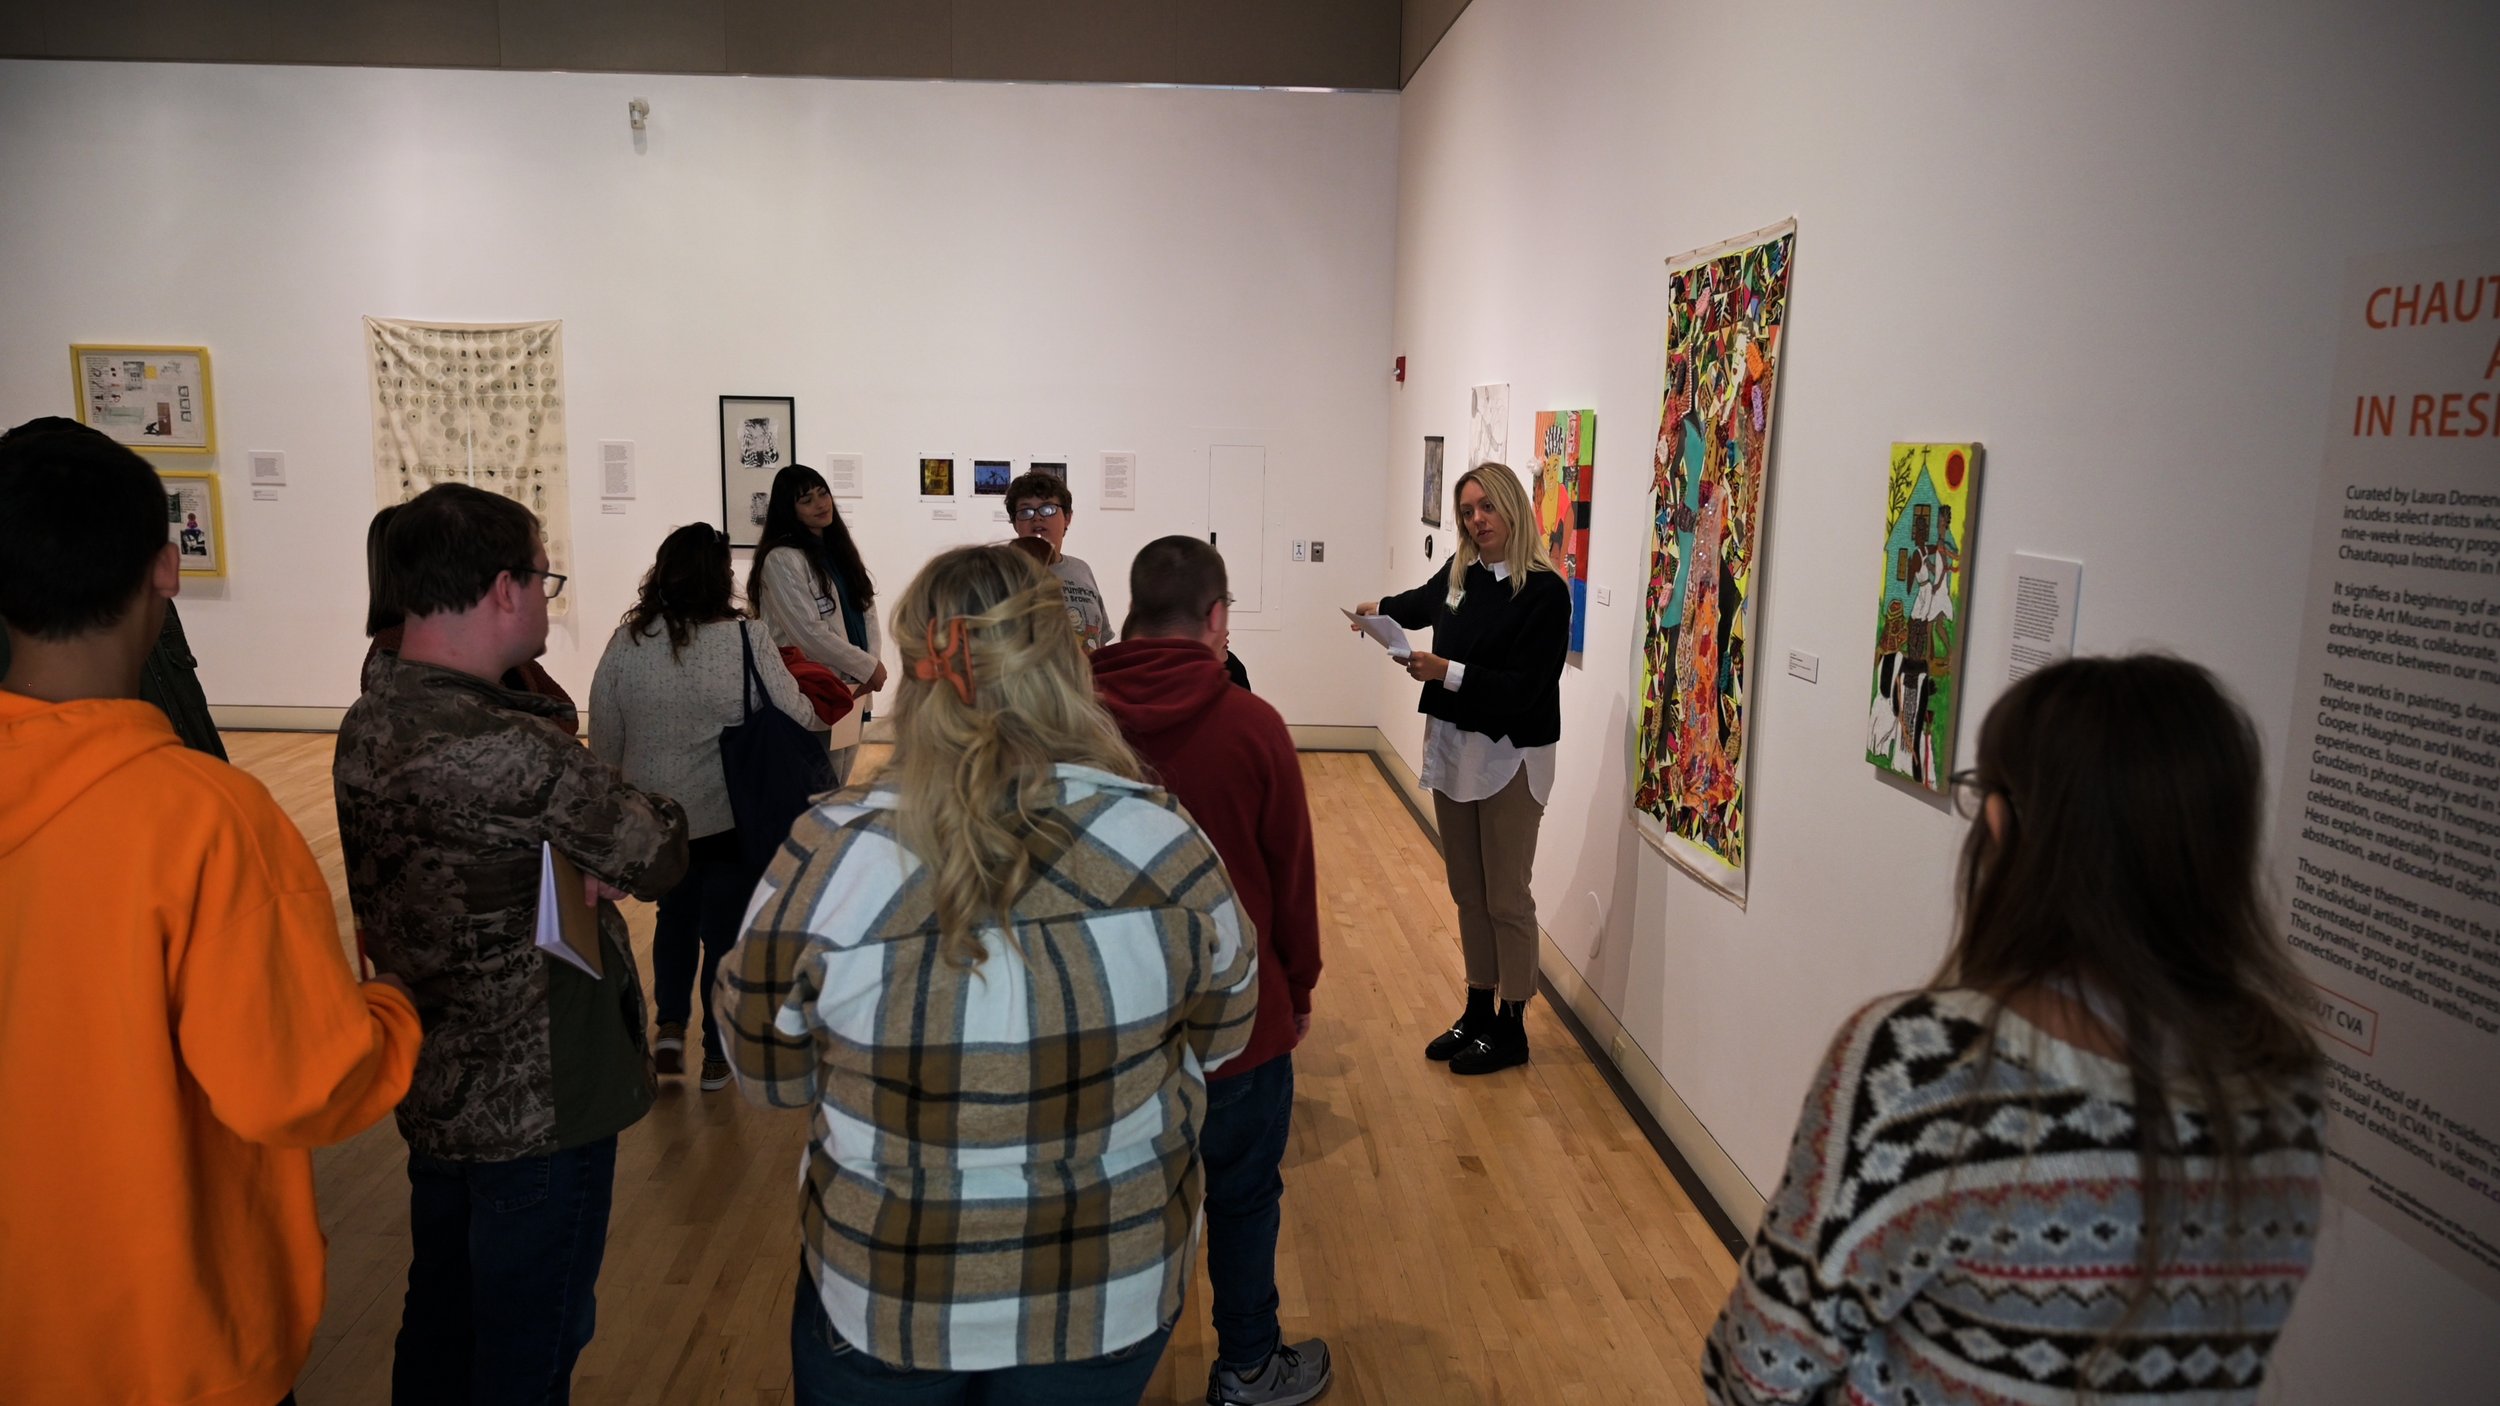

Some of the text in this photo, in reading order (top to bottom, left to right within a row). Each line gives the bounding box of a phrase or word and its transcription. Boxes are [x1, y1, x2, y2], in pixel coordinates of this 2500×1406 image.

[2354, 395, 2396, 437] IN
[2344, 506, 2391, 523] includes
[2393, 508, 2430, 526] select
[2431, 511, 2470, 528] artists
[2346, 485, 2392, 502] Curated
[2394, 486, 2410, 506] by
[2412, 488, 2446, 505] Laura
[2339, 545, 2493, 574] Chautauqua Institution in
[2341, 526, 2401, 544] nine-week
[2403, 531, 2464, 551] residency
[2332, 601, 2350, 616] the
[2353, 602, 2375, 619] Erie
[2376, 607, 2395, 623] Art
[2397, 610, 2451, 632] Museum
[2453, 620, 2480, 636] and
[2334, 581, 2343, 596] It
[2344, 583, 2391, 601] signifies
[2393, 591, 2401, 603] a
[2402, 588, 2469, 615] beginning
[2471, 598, 2487, 614] of
[2326, 641, 2394, 665] experiences
[2396, 651, 2451, 676] between
[2453, 664, 2477, 680] our
[2329, 622, 2498, 663] exchange ideas, collaborate,
[2319, 694, 2361, 714] explore
[2363, 703, 2382, 719] the
[2384, 710, 2463, 738] complexities
[2465, 726, 2480, 741] of
[2323, 673, 2355, 693] These
[2357, 684, 2391, 700] works
[2393, 688, 2405, 703] in
[2407, 694, 2462, 718] painting,
[2315, 733, 2499, 791] experiences. Issues of class and
[2317, 712, 2496, 768] Cooper, Haughton and Woods
[2310, 769, 2353, 795] Lawson,
[2355, 782, 2411, 812] Ransfield,
[2414, 802, 2438, 819] and
[2312, 750, 2494, 812] Grudzien's photography and in
[2305, 806, 2497, 881] Hess explore materiality through
[2307, 790, 2491, 857] celebration, censorship, trauma
[2302, 827, 2365, 860] abstraction,
[2367, 850, 2391, 867] and
[2393, 858, 2454, 888] discarded
[2295, 875, 2315, 894] The
[2316, 884, 2372, 917] individual
[2373, 906, 2409, 932] artists
[2411, 923, 2470, 955] grappled
[2298, 856, 2492, 942] Though these themes are not the
[2290, 912, 2311, 933] This
[2313, 923, 2360, 955] dynamic
[2362, 945, 2399, 971] group
[2400, 961, 2414, 976] of
[2415, 968, 2453, 993] artists
[2292, 897, 2364, 934] concentrated
[2366, 924, 2393, 946] time
[2394, 937, 2419, 957] and
[2421, 948, 2458, 973] space
[2287, 933, 2499, 1034] connections and conflicts within our
[2337, 1010, 2363, 1036] CVA
[2363, 1072, 2405, 1104] School
[2405, 1097, 2421, 1113] of
[2420, 1104, 2442, 1125] Art
[2337, 1078, 2371, 1108] Visual
[2372, 1099, 2397, 1122] Arts
[2437, 1131, 2452, 1152] To
[2455, 1141, 2488, 1174] learn
[2343, 1106, 2367, 1126] and
[2367, 1119, 2436, 1168] exhibitions,
